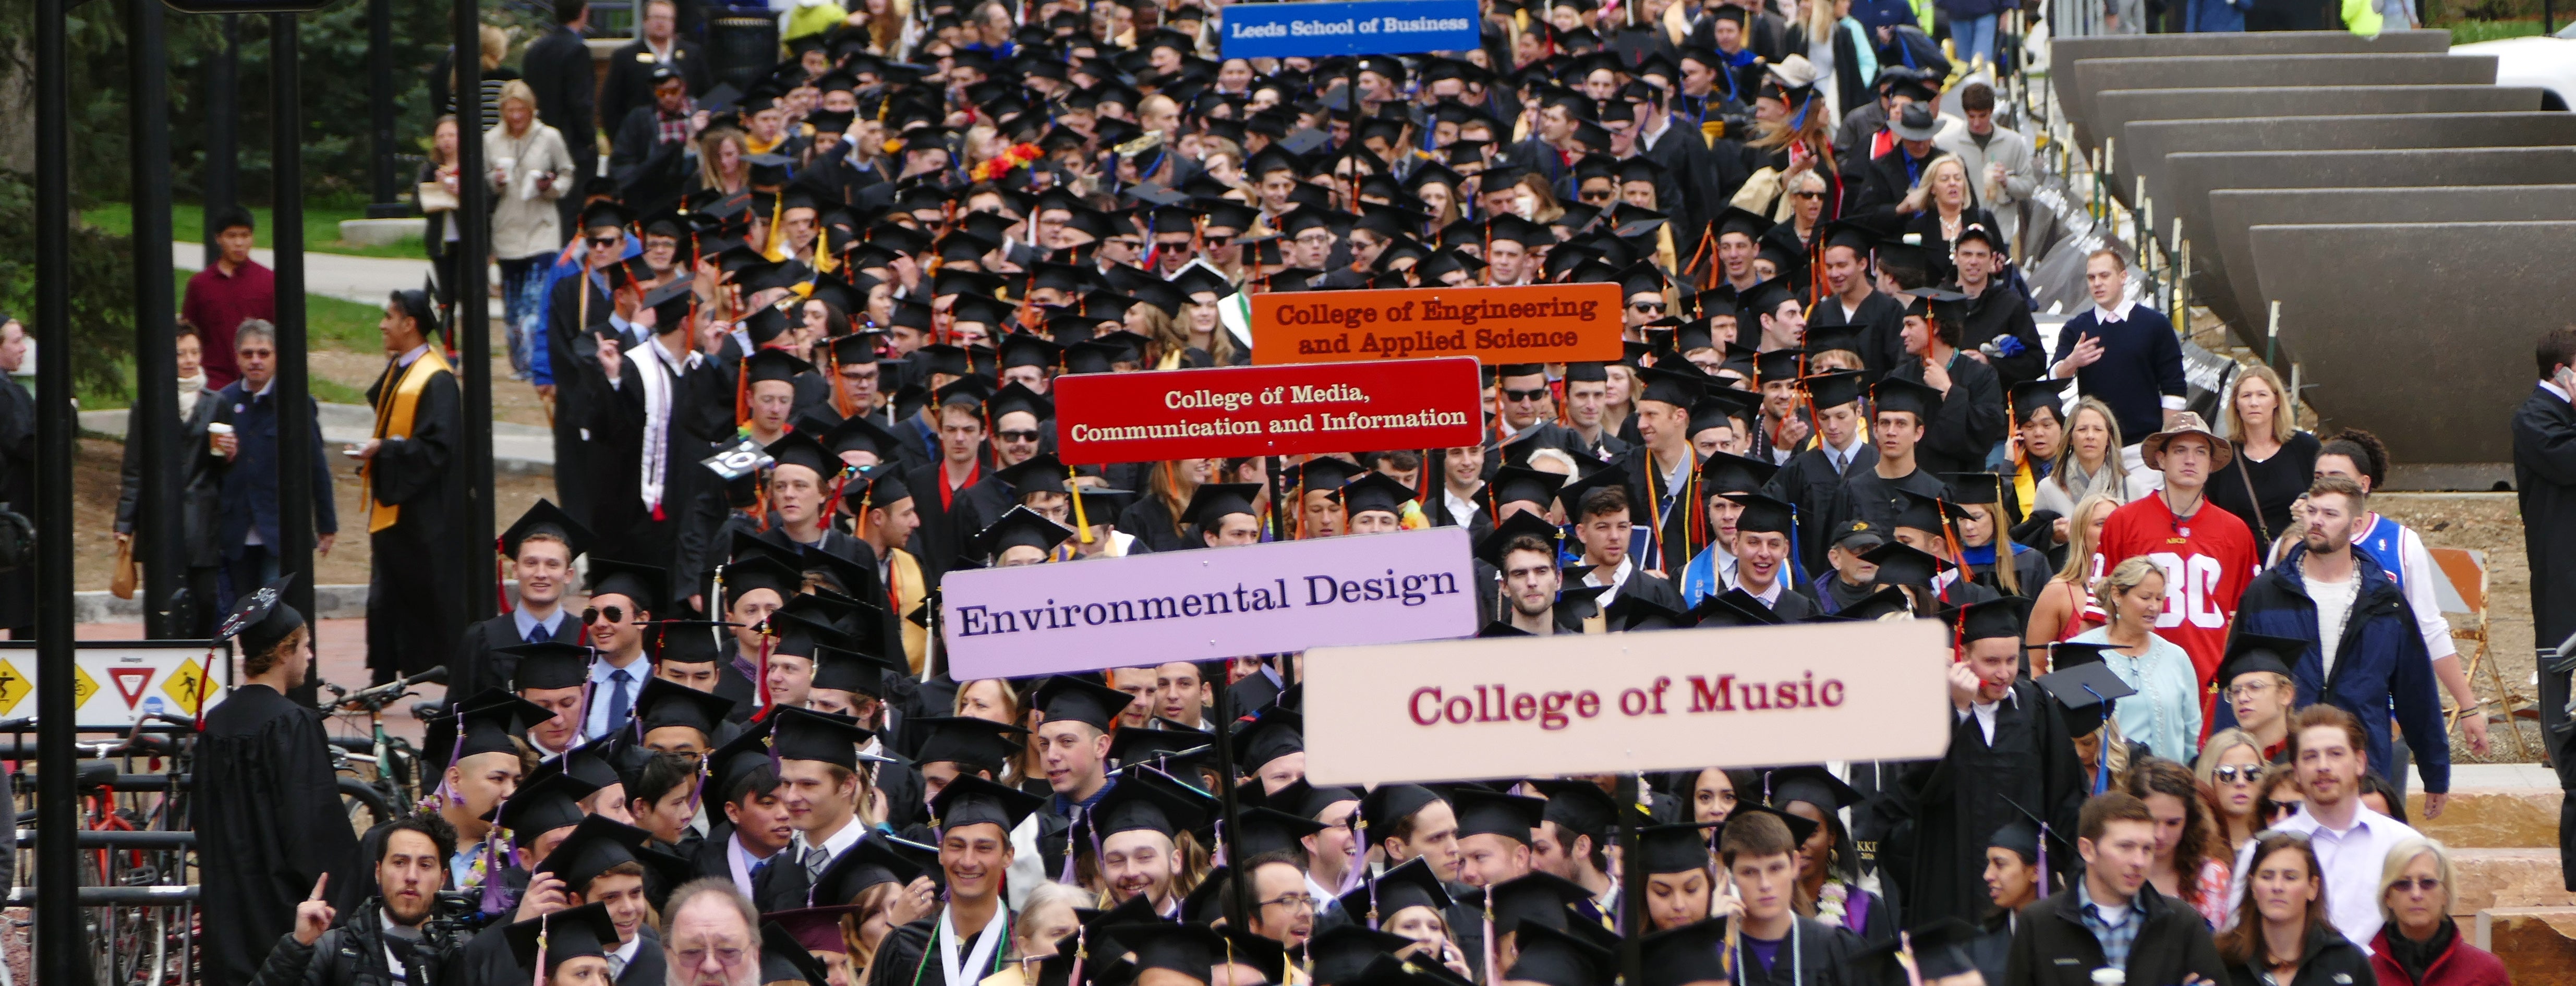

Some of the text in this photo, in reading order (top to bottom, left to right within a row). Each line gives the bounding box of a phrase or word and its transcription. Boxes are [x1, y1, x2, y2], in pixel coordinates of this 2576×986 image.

[1232, 17, 1469, 38] Leeds School of Business
[1276, 297, 1599, 329] College of Engineering
[1299, 328, 1578, 358] and Applied Science
[1165, 383, 1370, 411] College of Media,
[1071, 409, 1468, 442] Communication and Information
[956, 568, 1460, 637] Environmental Design
[1408, 671, 1845, 731] College of Music
